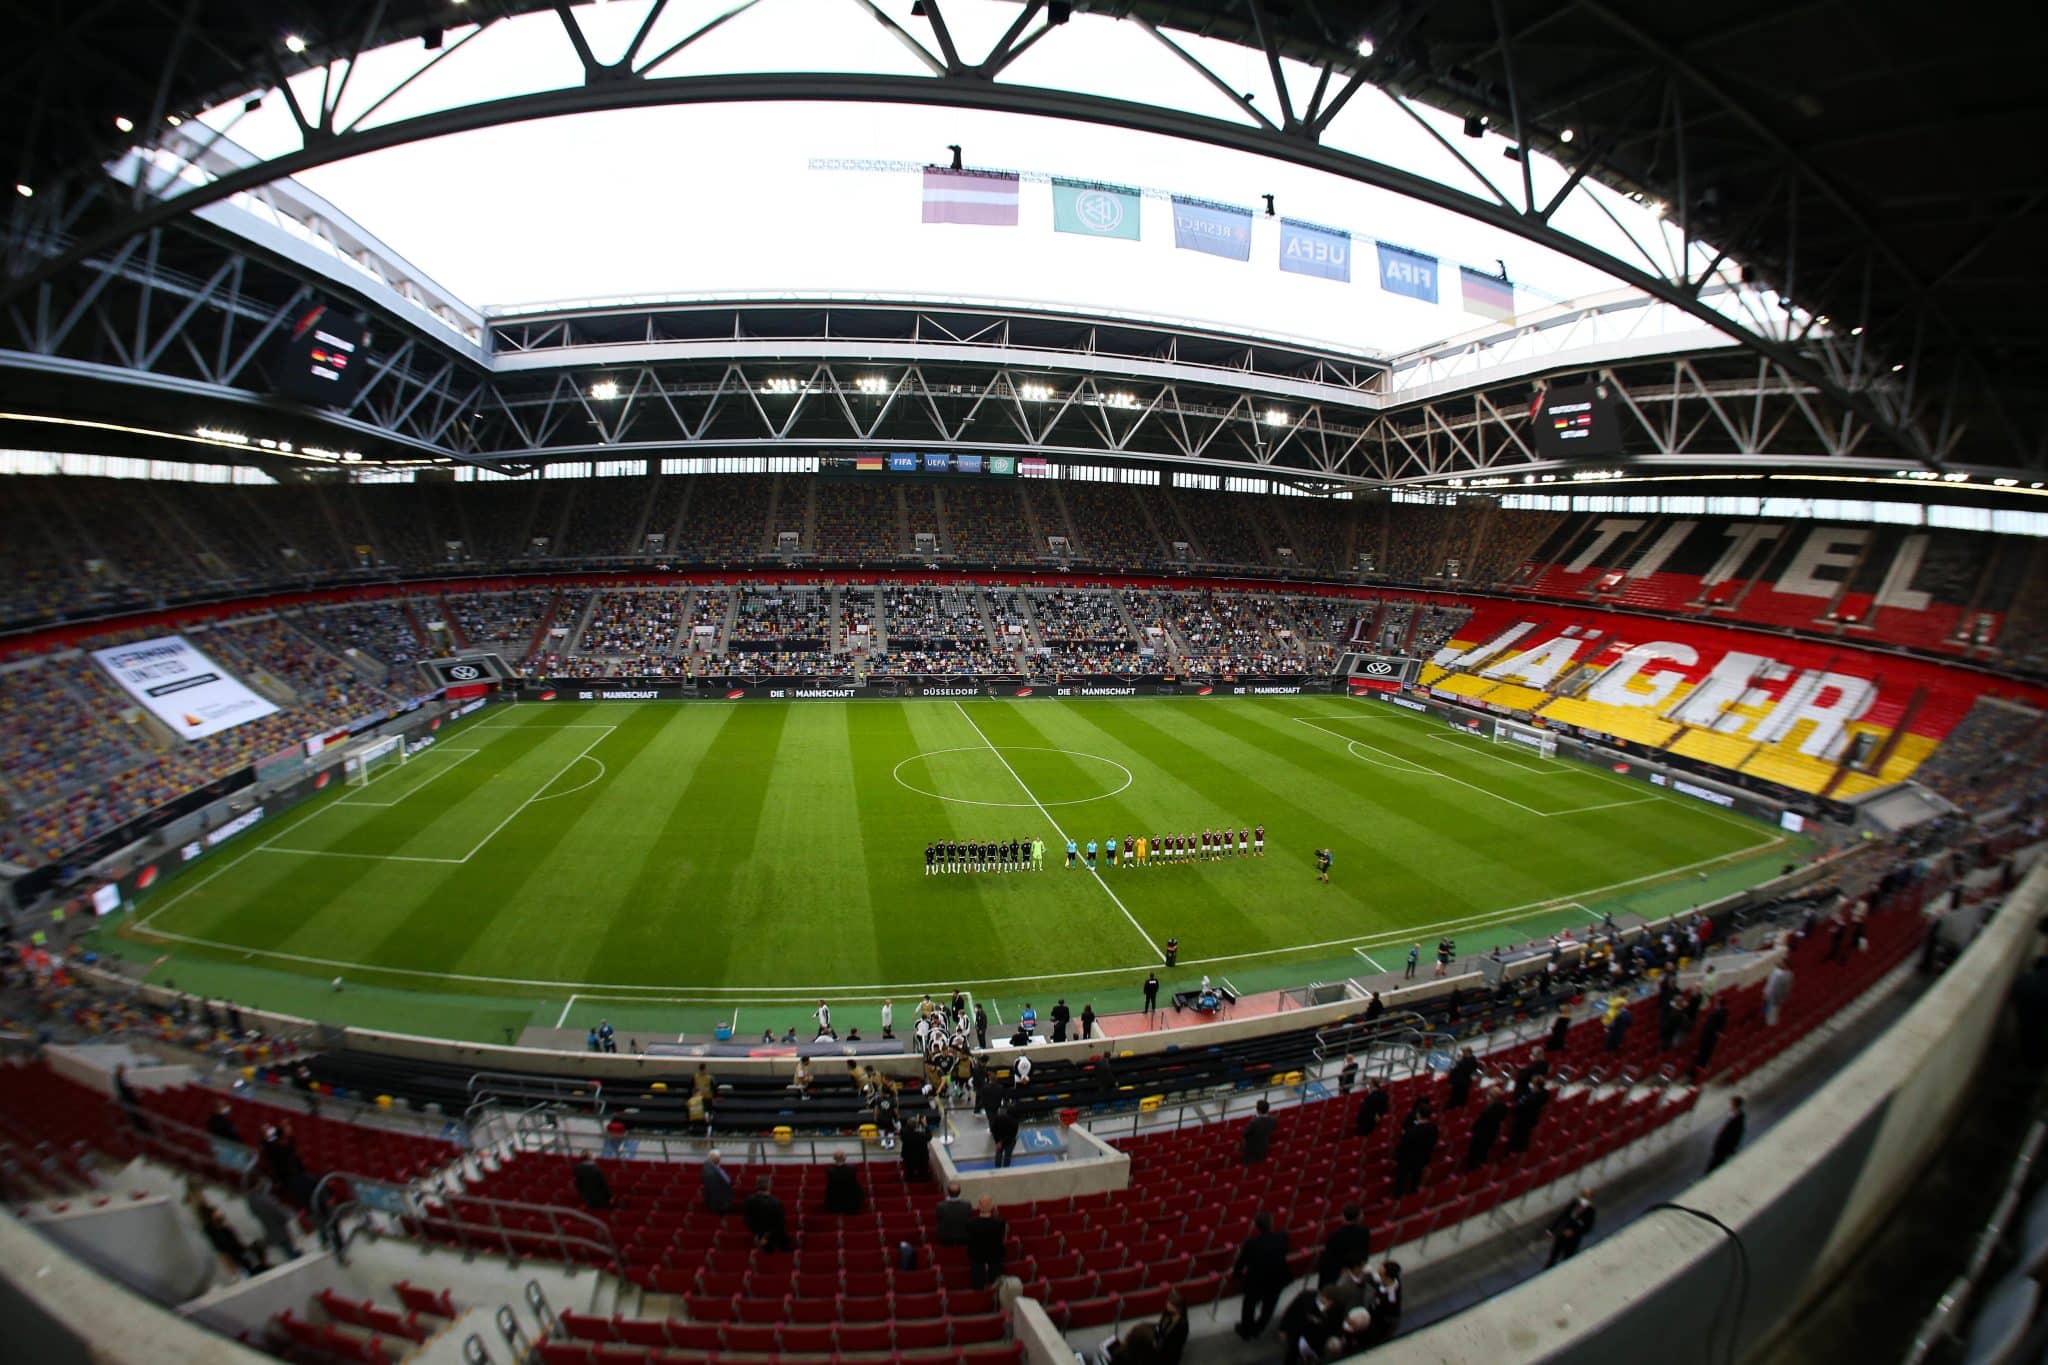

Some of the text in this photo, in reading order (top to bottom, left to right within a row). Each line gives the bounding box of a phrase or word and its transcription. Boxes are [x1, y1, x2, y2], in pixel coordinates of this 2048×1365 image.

[894, 458, 912, 467] FIFA
[927, 459, 946, 468] UEFA
[1563, 519, 1932, 612] TITEL
[770, 689, 855, 698] DIE MANNSCHAFT
[923, 688, 979, 697] DÜSSELDORF
[1057, 687, 1136, 696] DIE MANNSCHAFT
[1234, 686, 1301, 695] DIE MANNSCHAFT
[1431, 621, 1879, 762] JÄGER
[579, 691, 659, 700] DIE MANNSCHAFT
